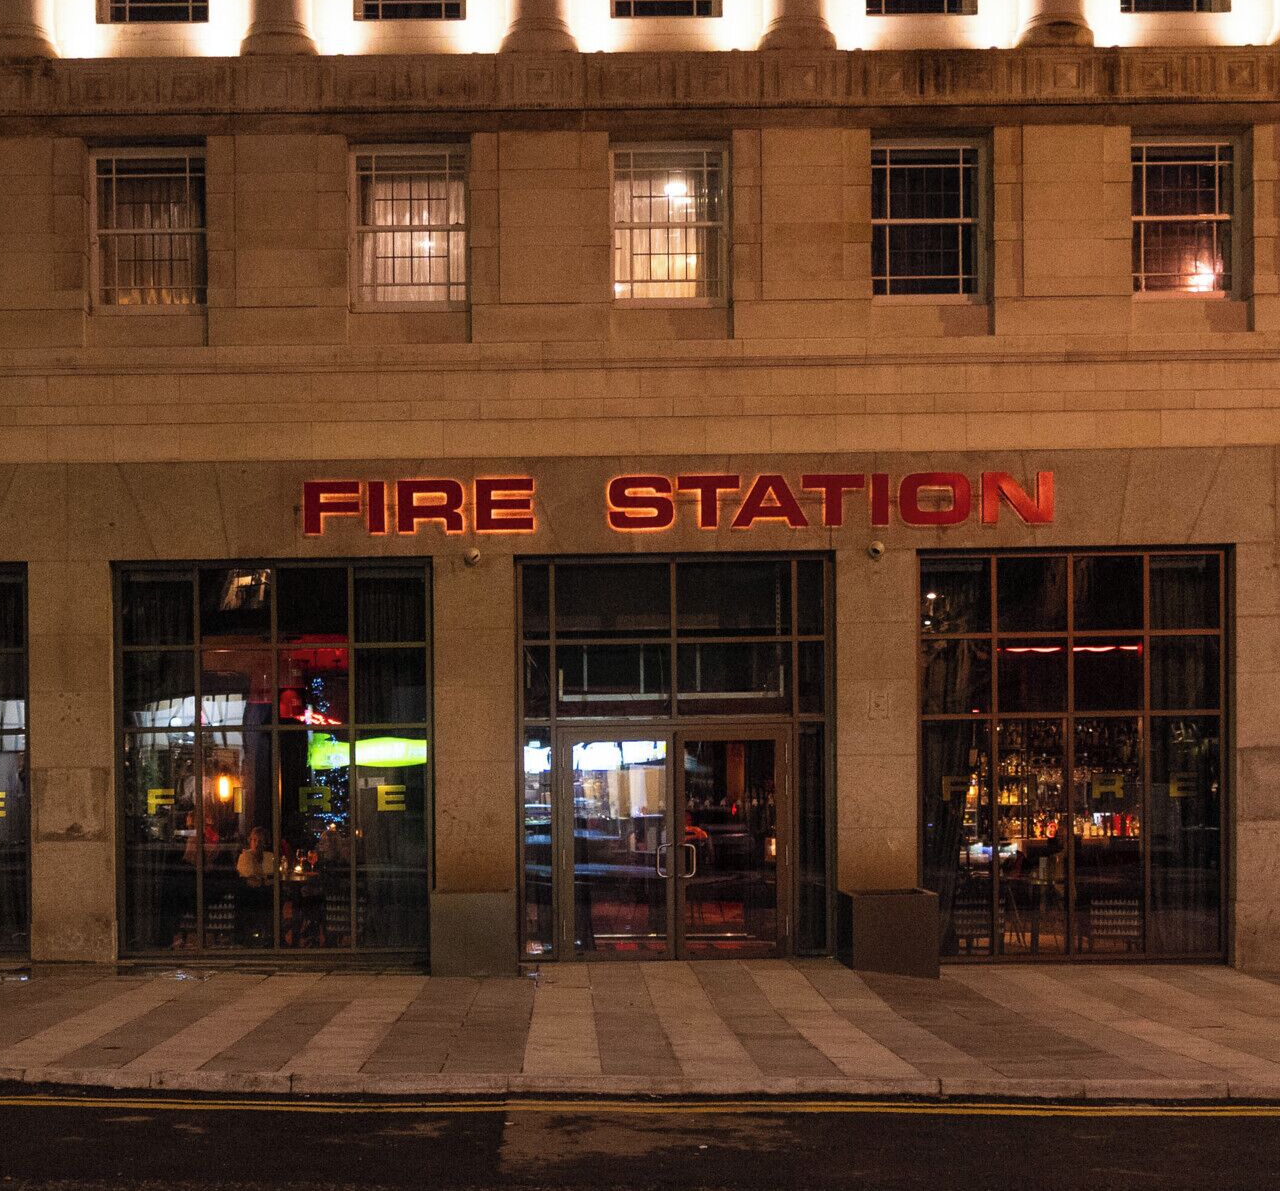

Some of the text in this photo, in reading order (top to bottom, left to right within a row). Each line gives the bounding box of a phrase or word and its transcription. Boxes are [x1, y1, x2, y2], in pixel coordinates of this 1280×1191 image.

[302, 470, 1055, 536] FIRE STATION
[146, 784, 407, 815] FIRE
